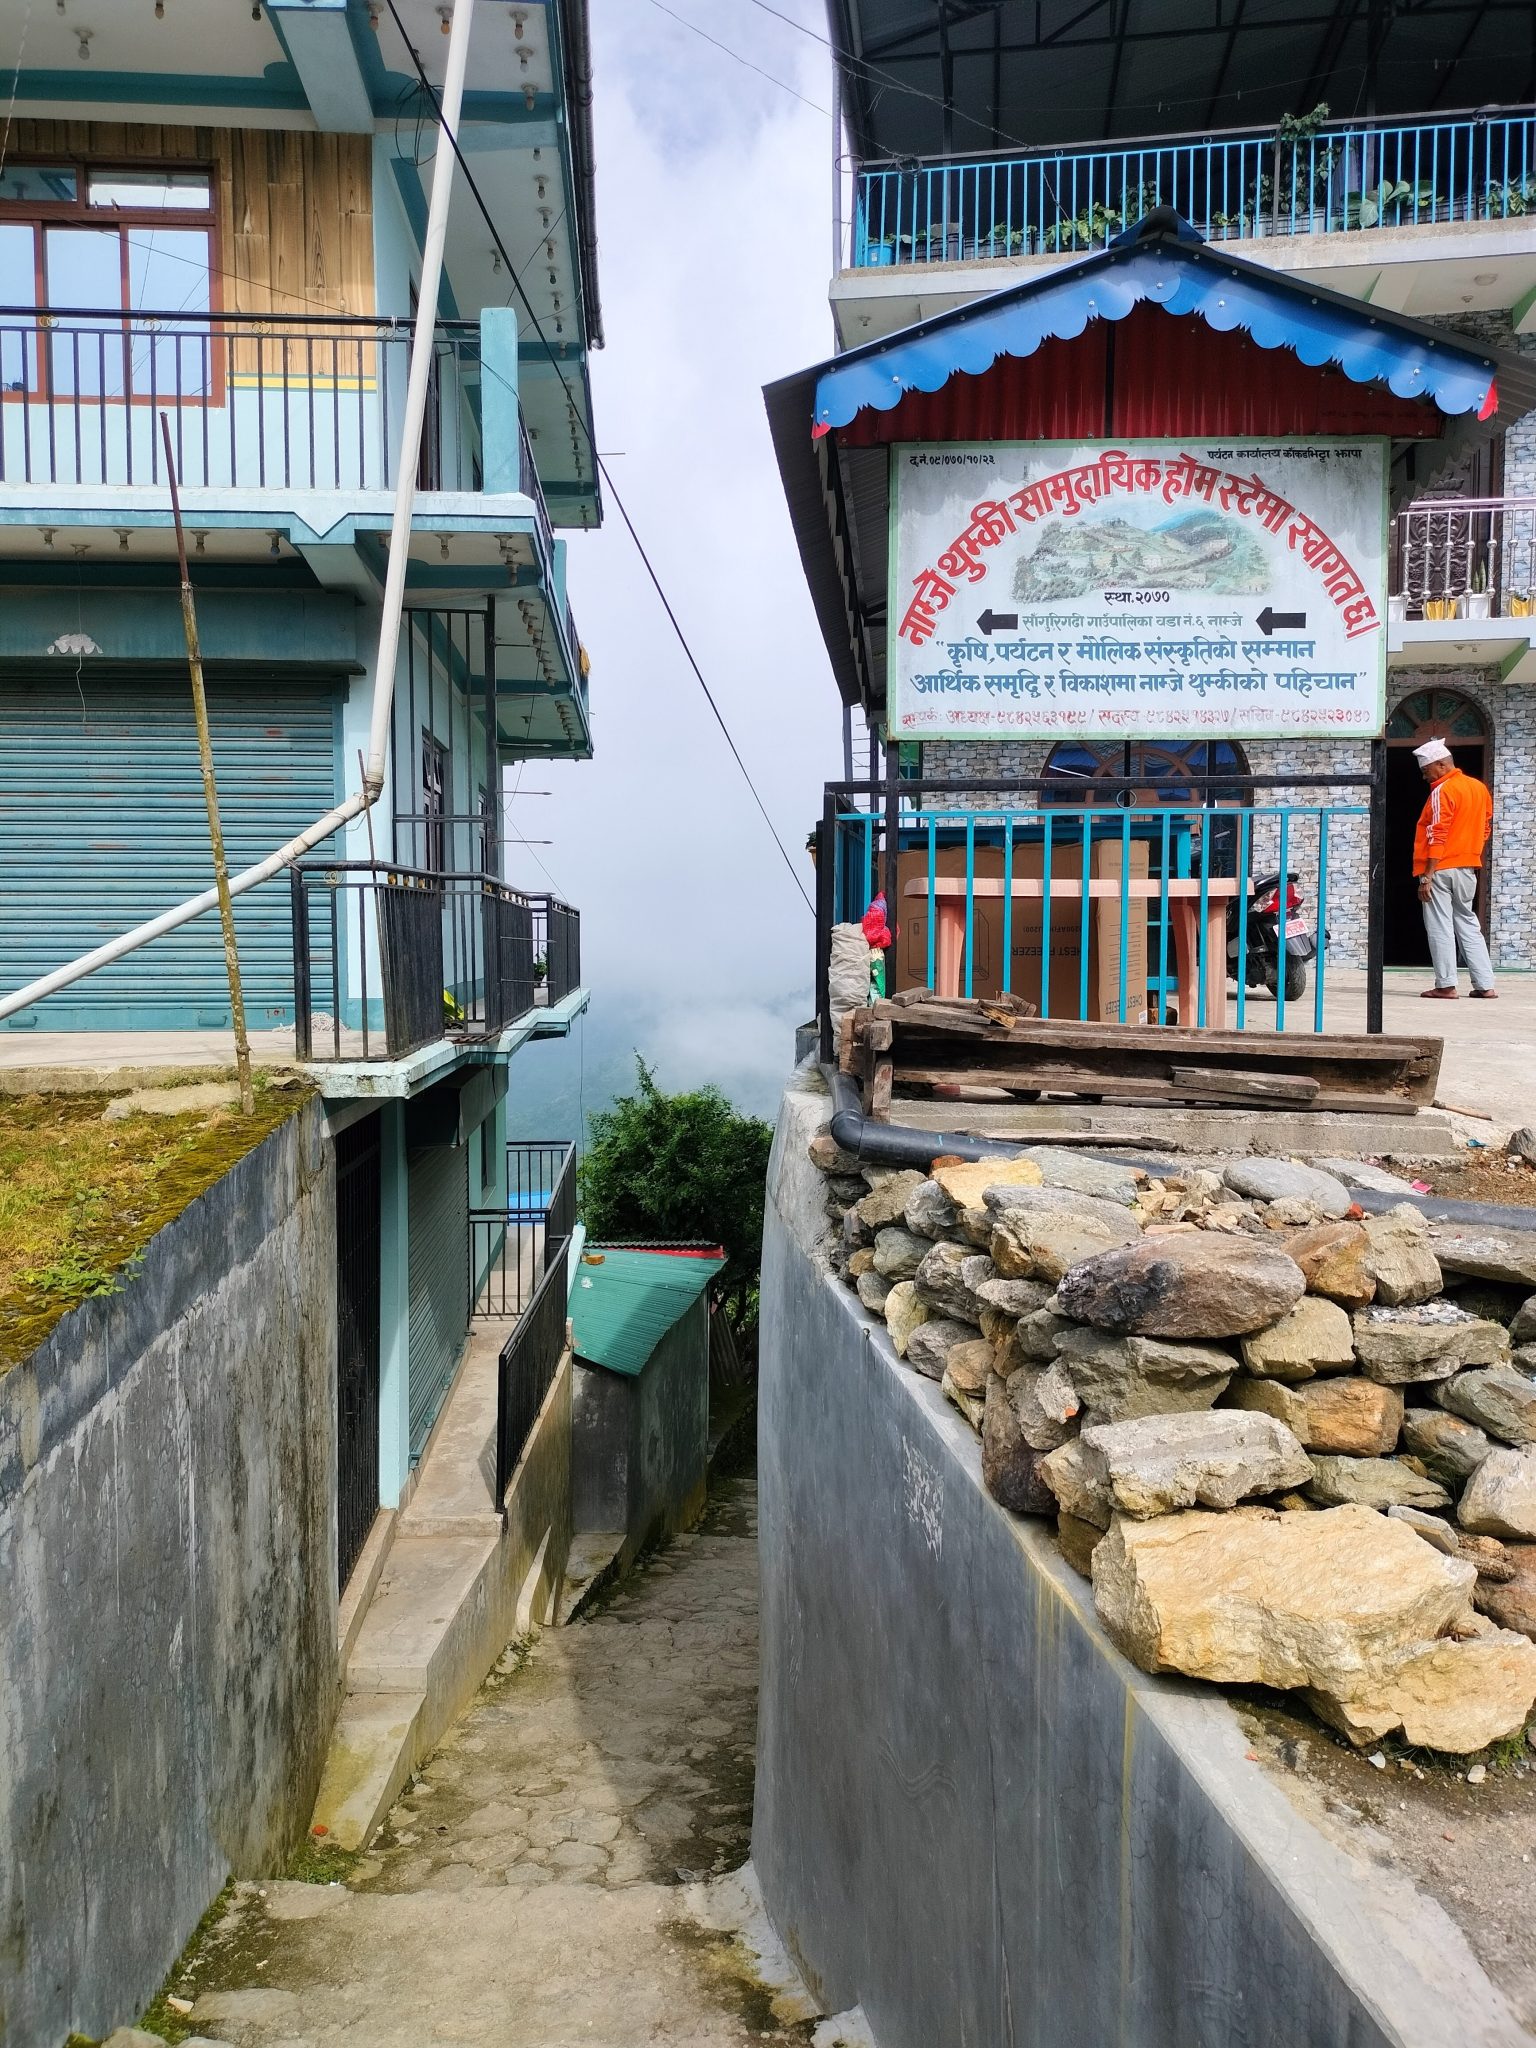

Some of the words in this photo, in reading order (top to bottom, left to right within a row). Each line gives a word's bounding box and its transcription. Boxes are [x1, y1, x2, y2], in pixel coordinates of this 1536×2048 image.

[1207, 448, 1234, 460] पर्यटन
[1236, 448, 1282, 460] कार्यालय
[1335, 448, 1363, 459] झापा
[898, 568, 957, 646] नाम्जे
[937, 501, 1017, 582] थुम्की
[1008, 450, 1161, 522] सामुदायिक
[1162, 452, 1222, 504] होम
[1156, 615, 1181, 627] वडा
[1058, 642, 1072, 665] र
[1076, 635, 1141, 665] मौलिक
[1143, 635, 1238, 667] संस्कृतिको
[1241, 641, 1316, 664] सम्मान
[910, 669, 981, 694] आर्थिक
[1044, 674, 1056, 698] र
[1139, 668, 1184, 692] नाम्जे
[1188, 668, 1268, 697] थुम्कीको
[1012, 946, 1056, 957] FEEZER
